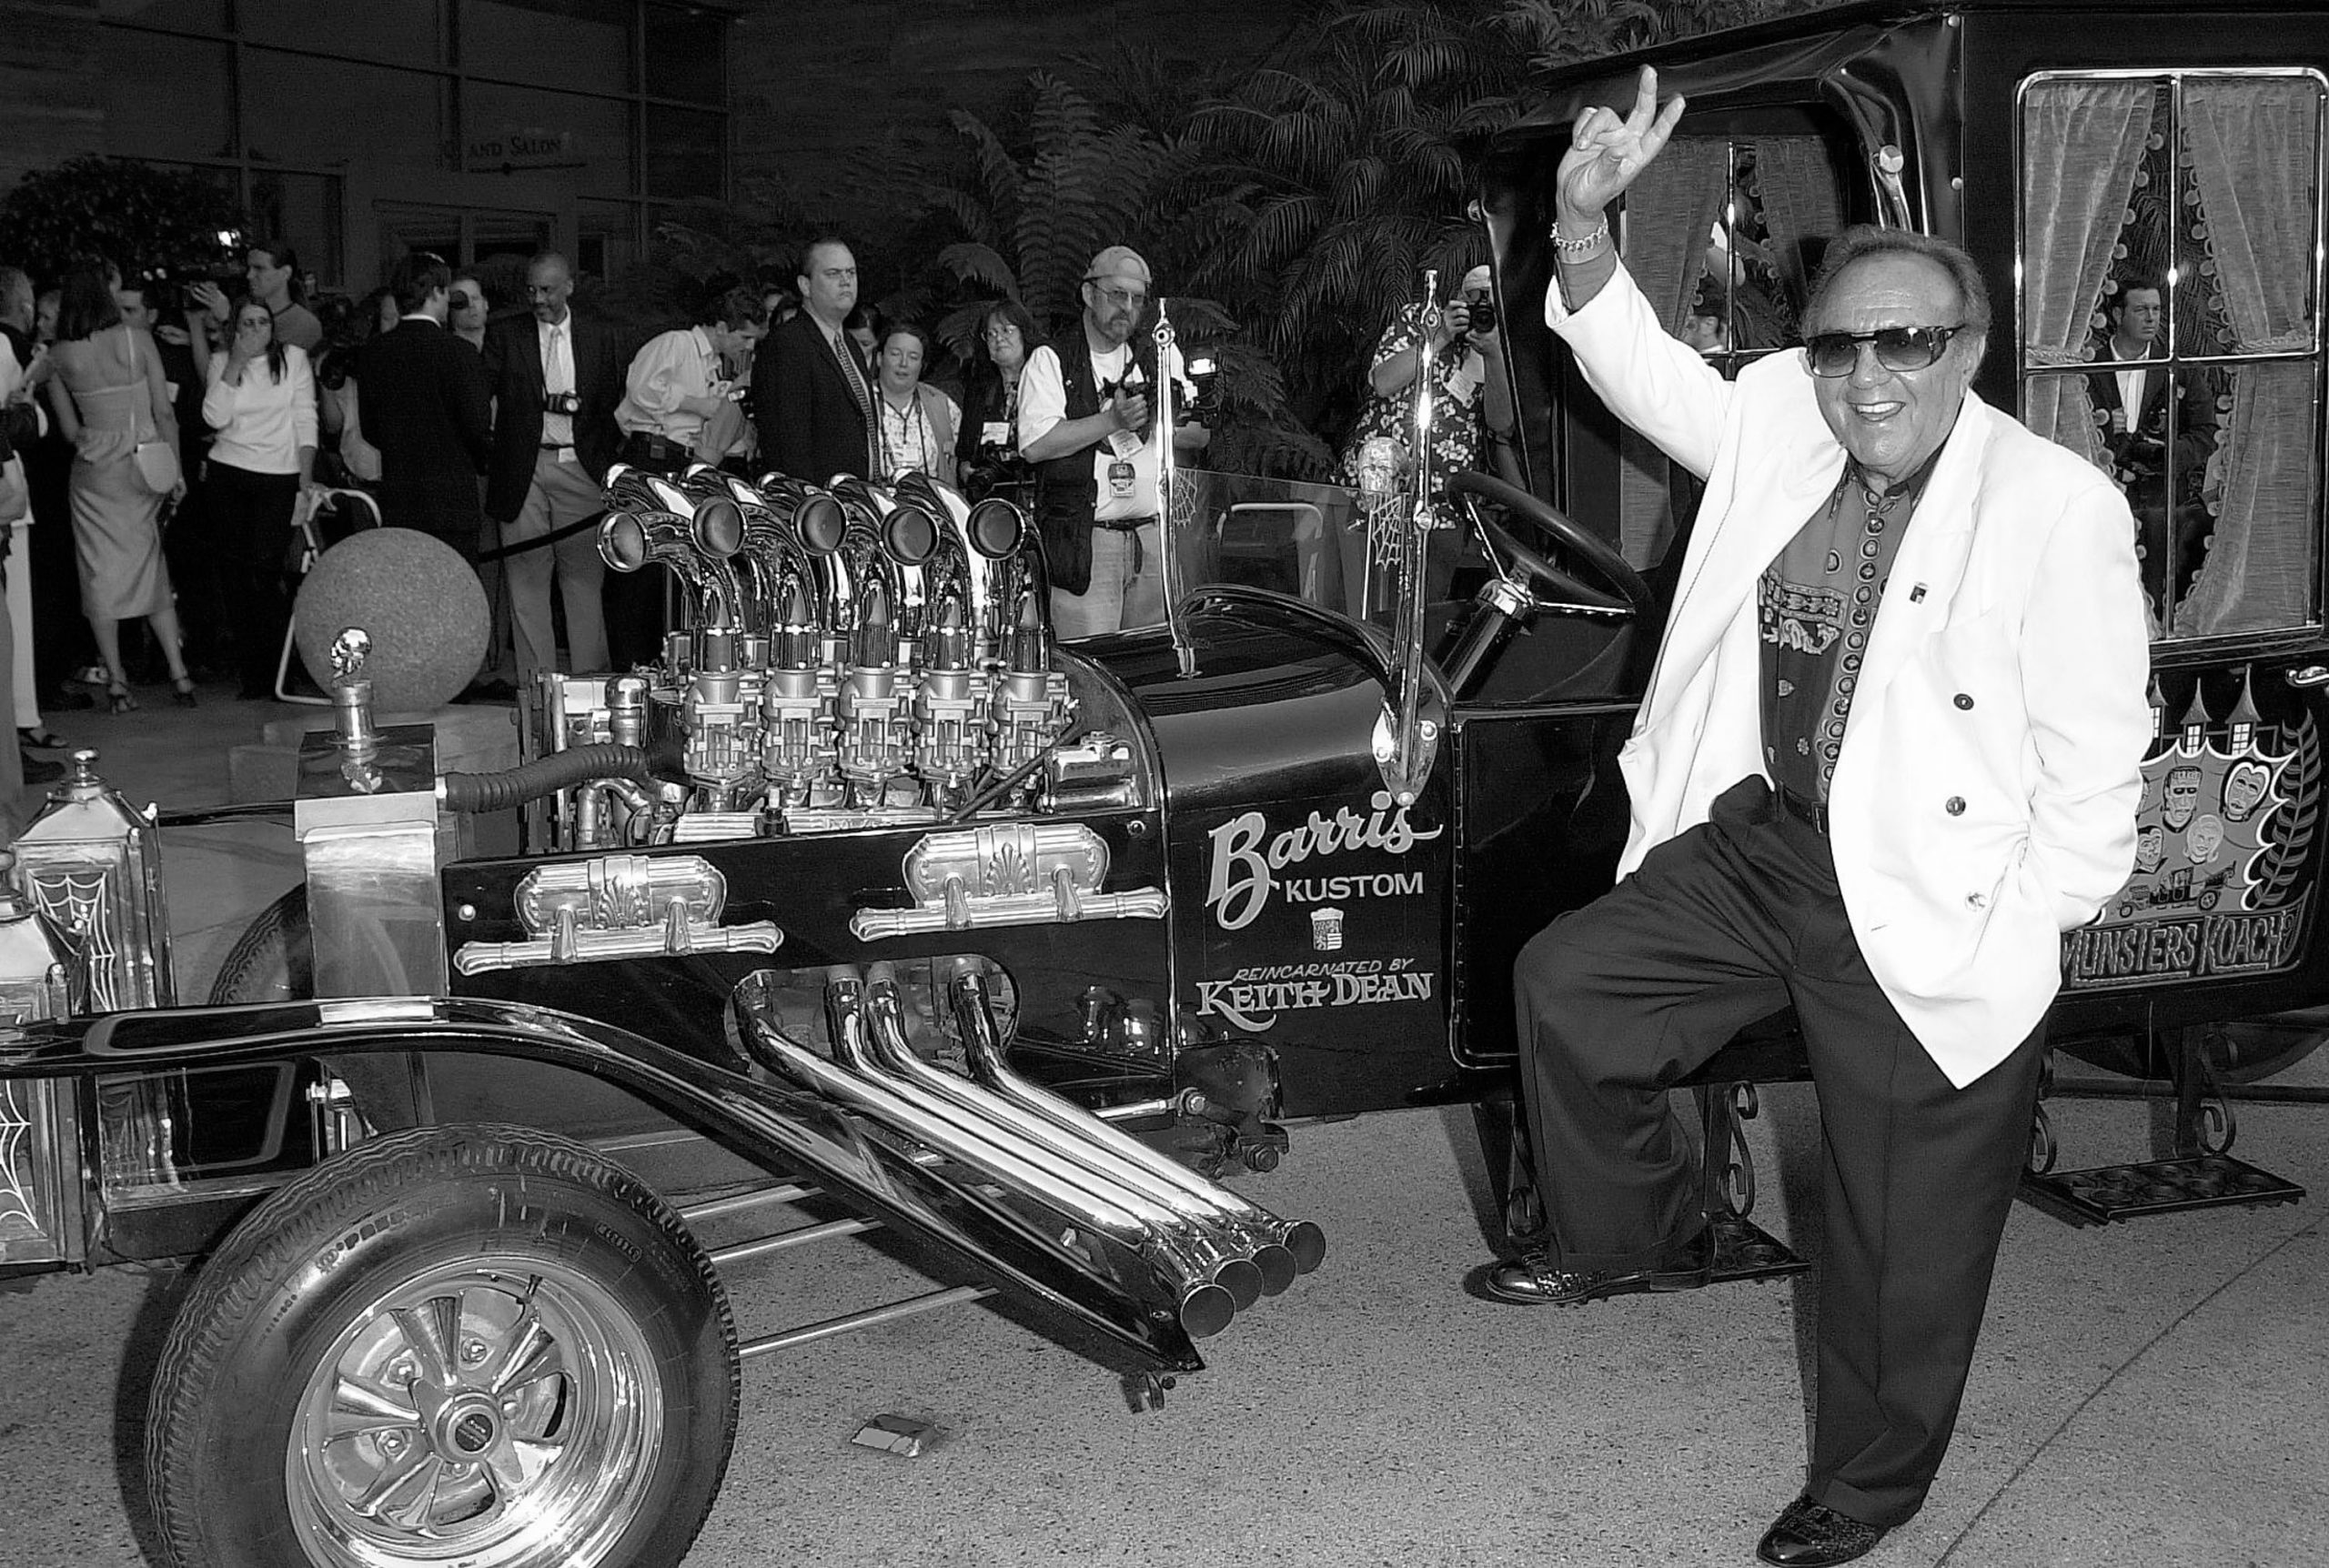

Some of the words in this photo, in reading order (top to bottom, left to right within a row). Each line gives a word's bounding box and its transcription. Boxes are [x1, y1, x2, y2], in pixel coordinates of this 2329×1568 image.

[1205, 790, 1444, 930] Barris
[1285, 871, 1425, 903] KUSTOM
[1232, 960, 1382, 981] REINCARNATED
[1388, 958, 1415, 971] BY
[2197, 912, 2289, 975] KOACH
[1195, 980, 1330, 1031] KEITH
[1331, 972, 1434, 1006] DEAN
